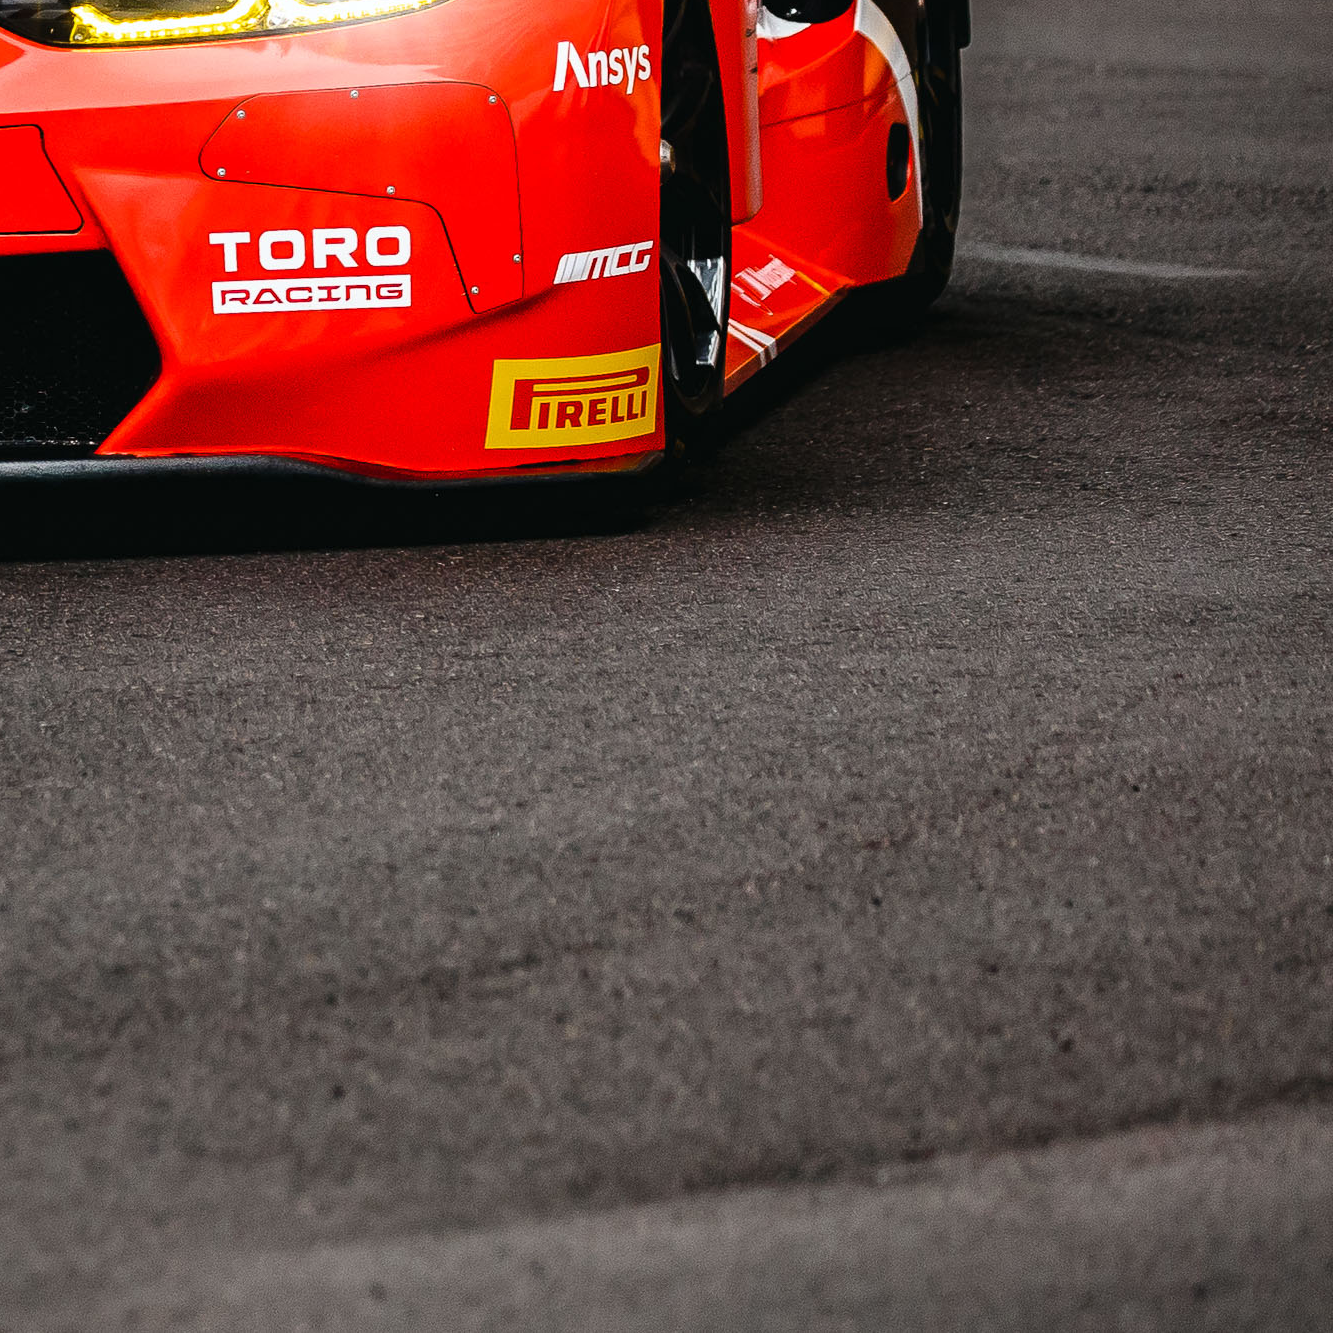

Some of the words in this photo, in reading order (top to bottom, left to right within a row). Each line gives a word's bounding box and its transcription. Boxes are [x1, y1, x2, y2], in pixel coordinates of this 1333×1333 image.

[553, 41, 652, 95] Ansys
[209, 225, 412, 272] TORO
[220, 282, 405, 306] RACING
[510, 366, 651, 431] PIRELLI
